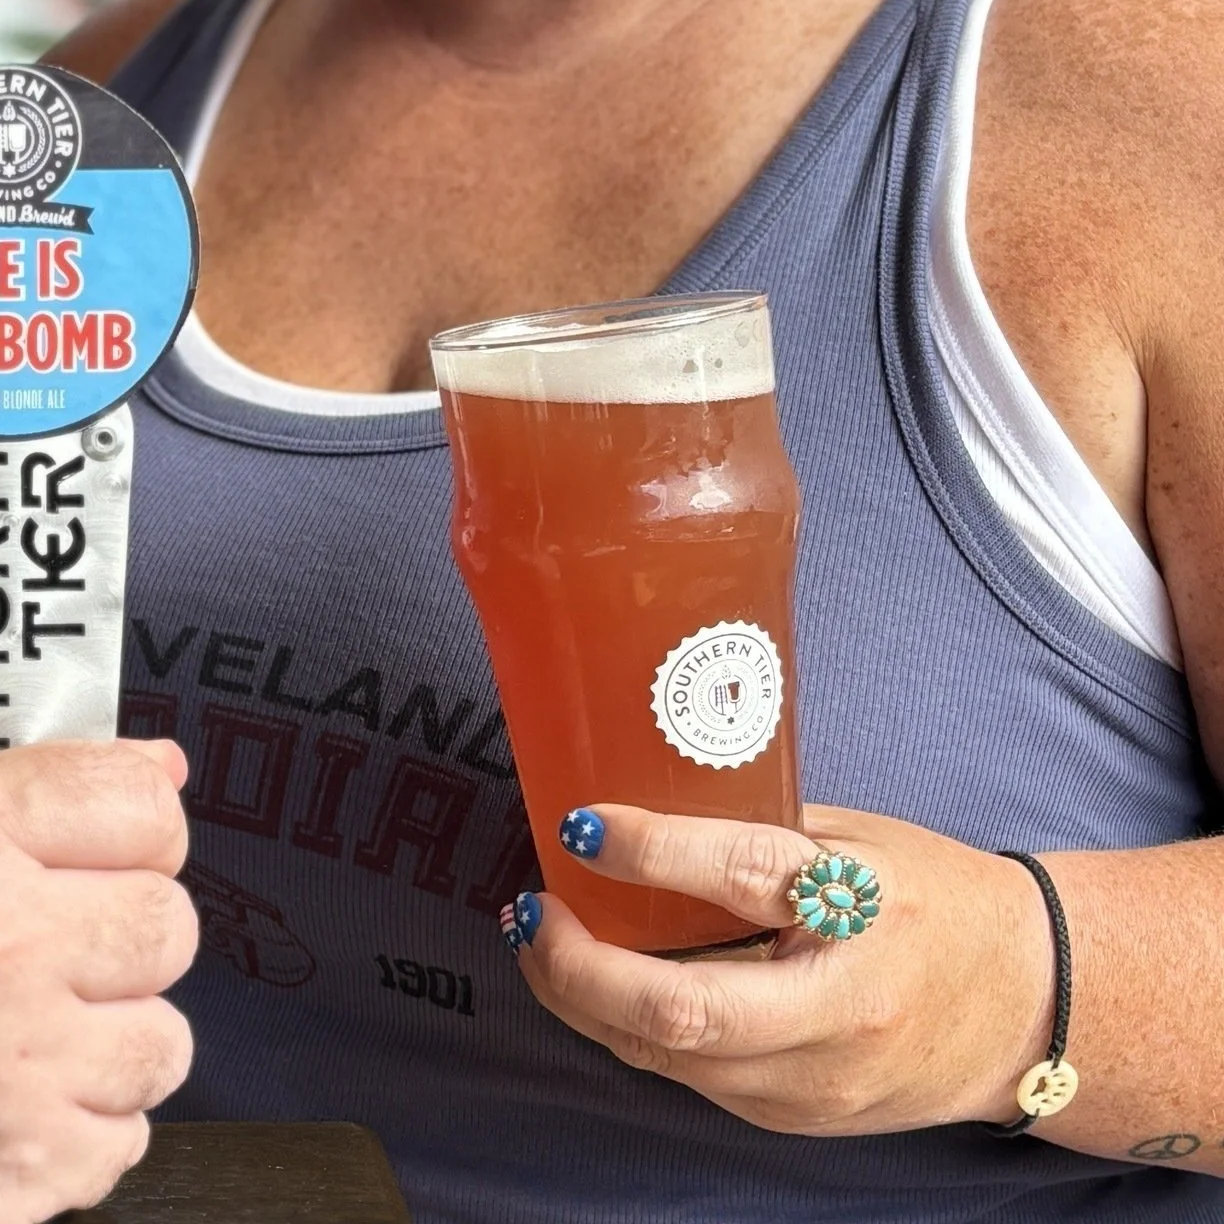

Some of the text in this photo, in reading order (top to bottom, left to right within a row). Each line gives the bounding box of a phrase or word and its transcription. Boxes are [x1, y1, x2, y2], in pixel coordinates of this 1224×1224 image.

[46, 96, 74, 157] TIER
[36, 170, 56, 190] CO
[36, 238, 83, 300] IS
[3, 389, 45, 409] BLONDE
[47, 389, 66, 409] ALE
[20, 452, 86, 661] TIER
[130, 618, 516, 780] VELAN
[673, 641, 772, 718] SOUTHERN TIER
[693, 715, 764, 746] BREWING CO
[373, 954, 476, 1018] 1901
